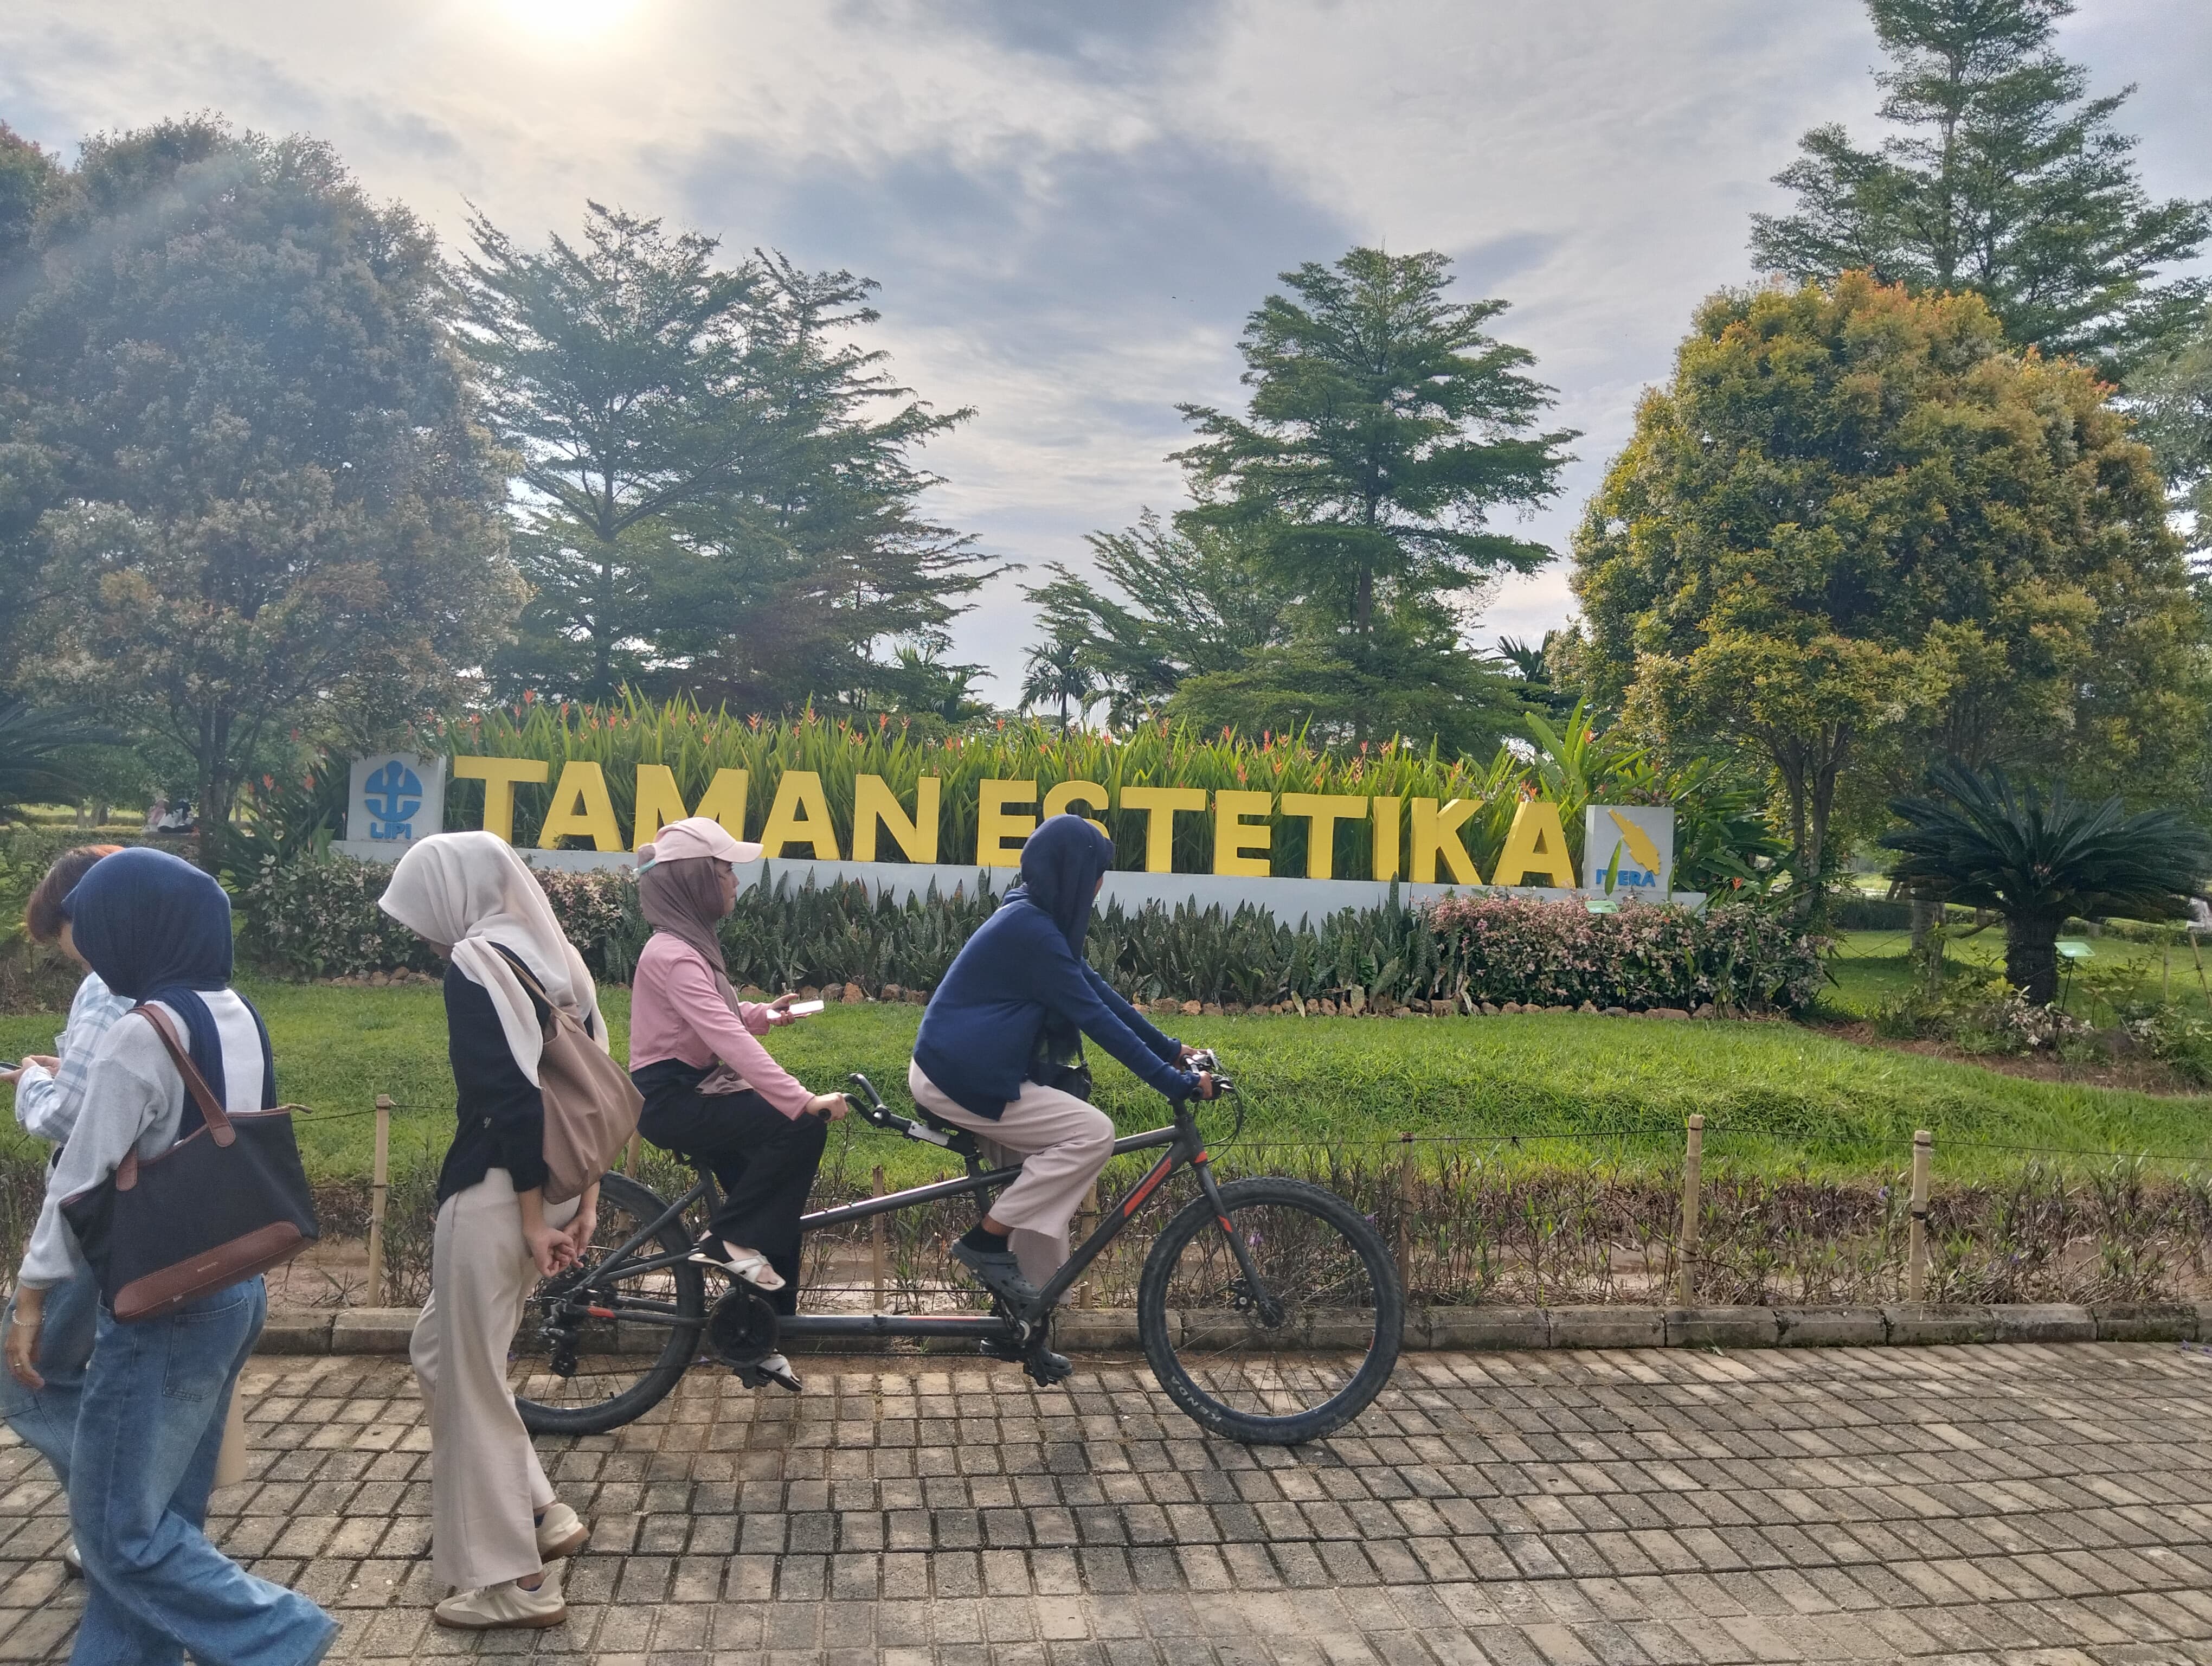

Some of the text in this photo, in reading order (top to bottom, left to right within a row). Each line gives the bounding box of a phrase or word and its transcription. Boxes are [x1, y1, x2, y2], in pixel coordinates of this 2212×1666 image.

[370, 822, 412, 839] LIPI
[454, 755, 941, 864] TAMAN
[1172, 1375, 1222, 1422] KENDA
